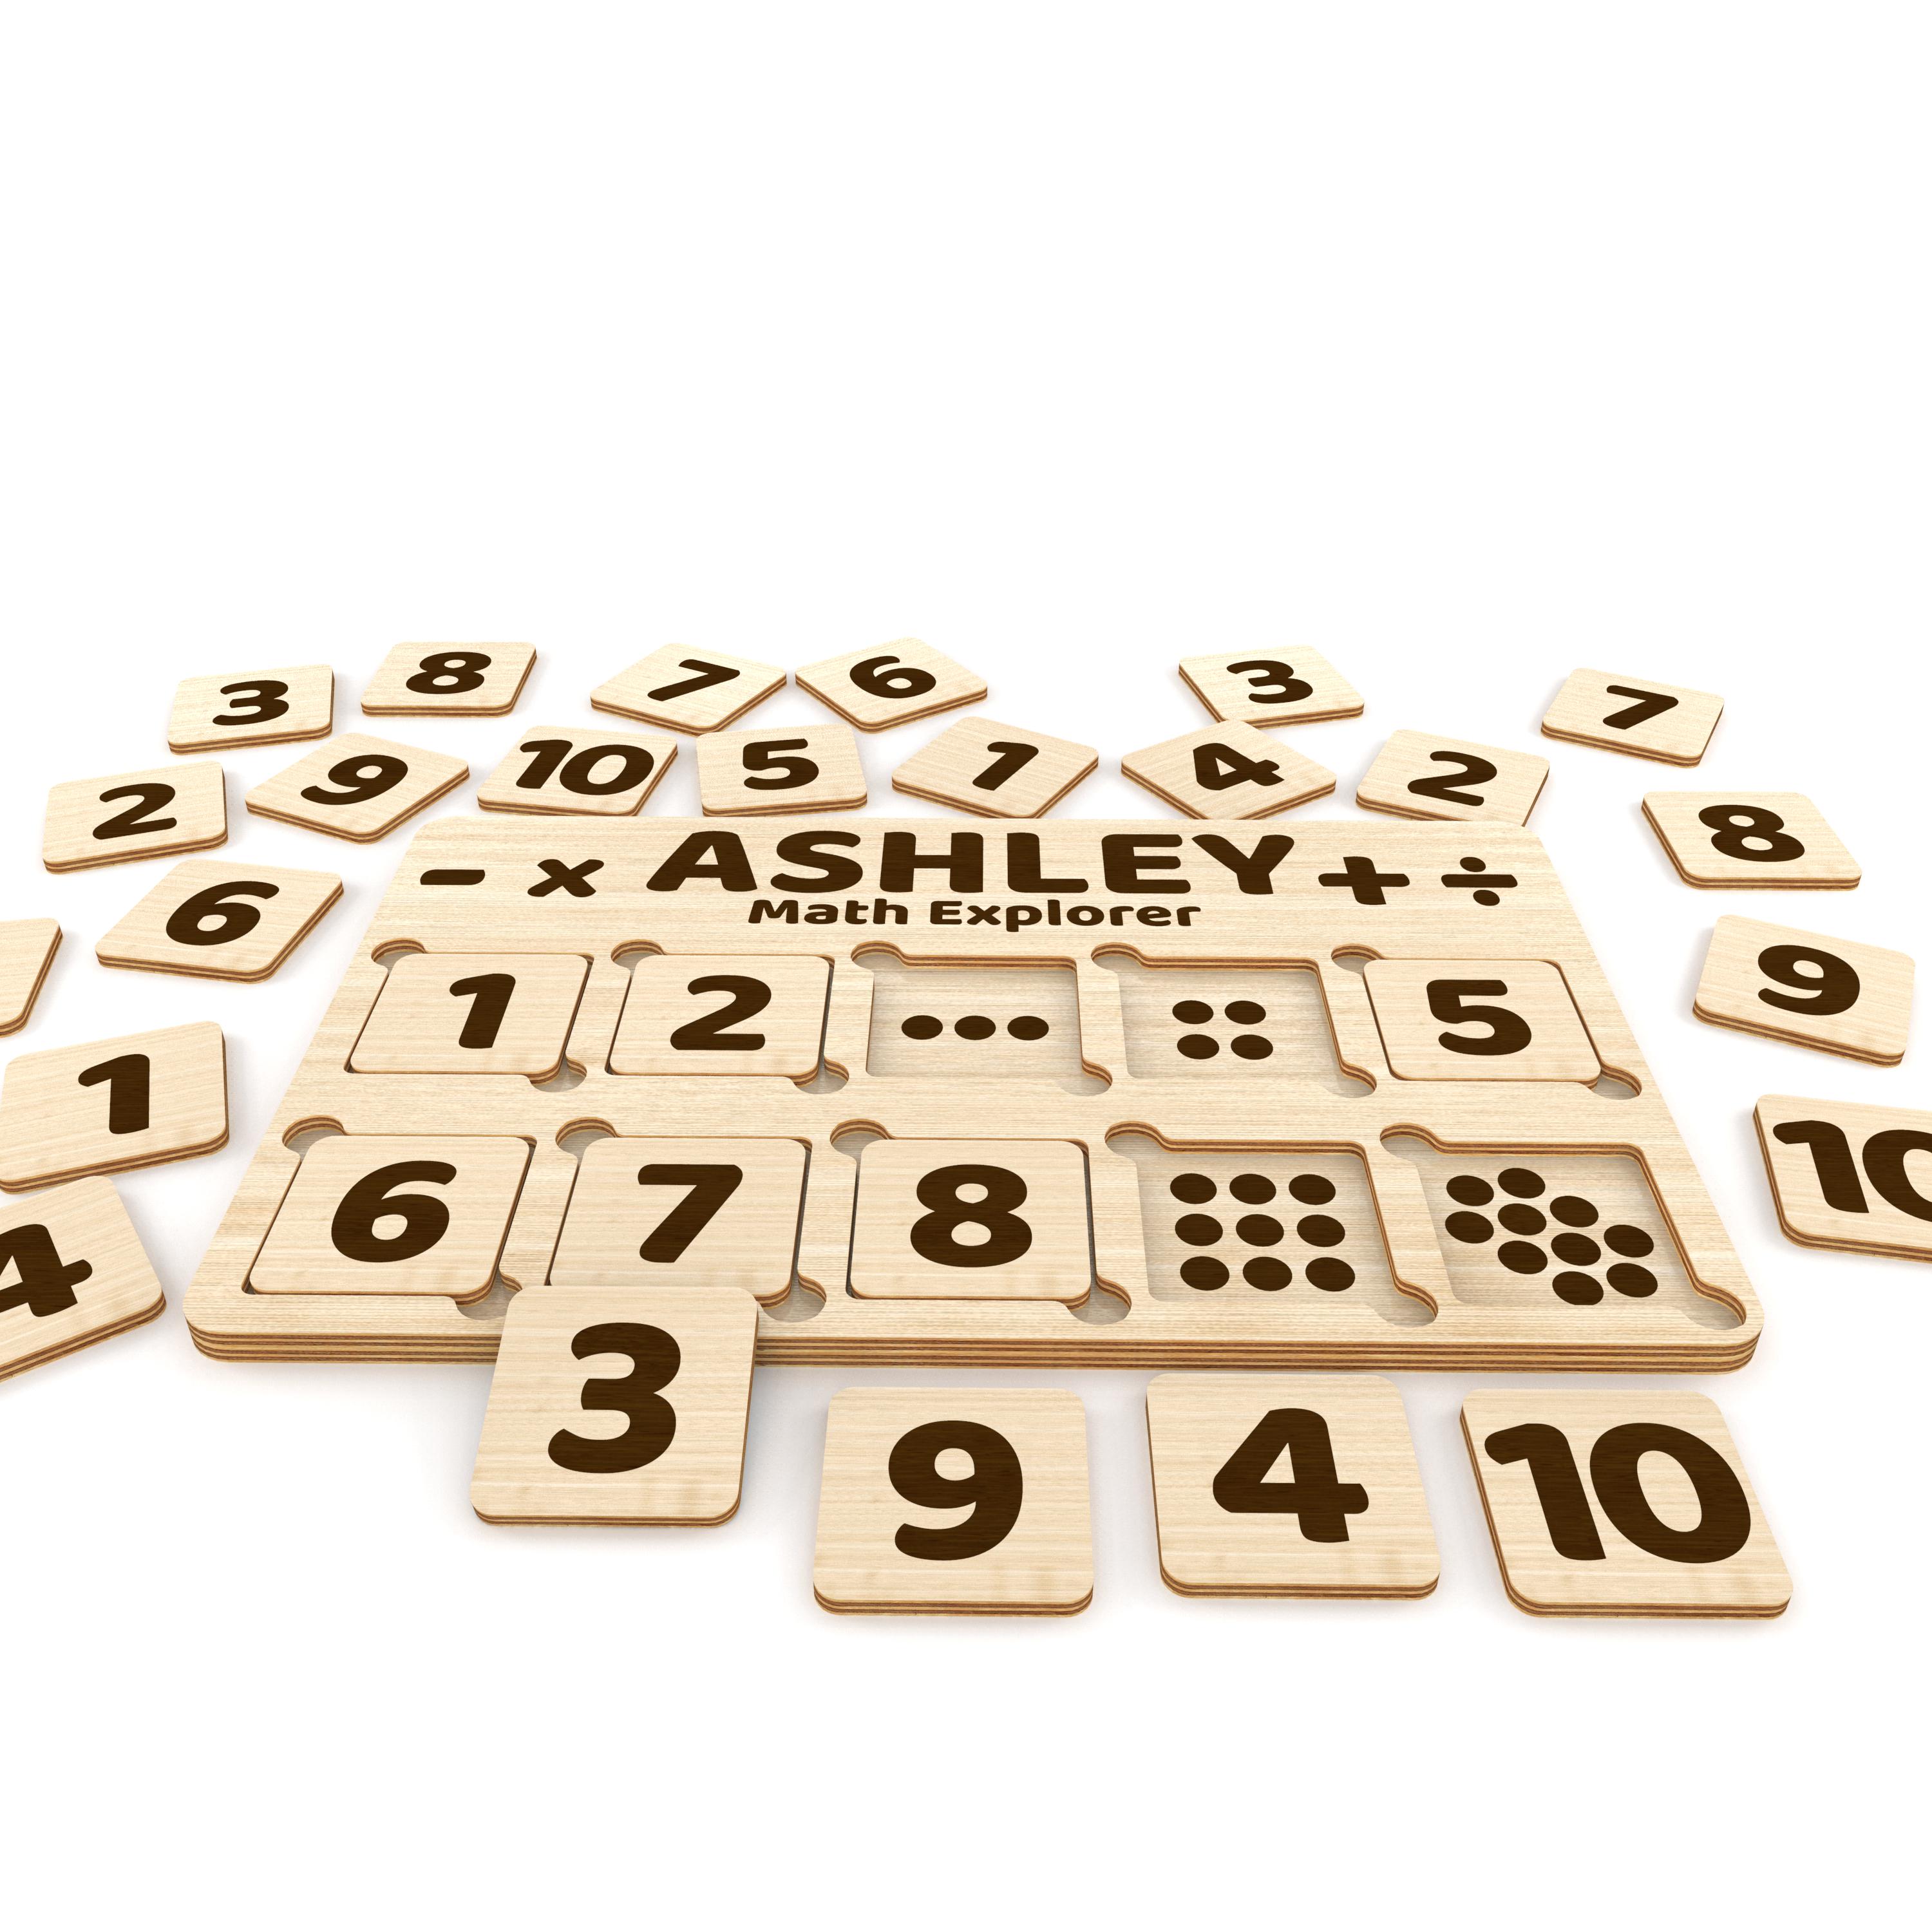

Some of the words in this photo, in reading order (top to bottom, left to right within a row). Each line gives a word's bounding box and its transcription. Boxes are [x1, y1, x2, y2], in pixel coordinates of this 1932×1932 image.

[213, 681, 289, 725] 3
[406, 652, 491, 694] 8
[648, 659, 740, 701] 7
[850, 656, 936, 698] 6
[1227, 661, 1312, 703] 3
[1603, 685, 1678, 730] 7
[301, 755, 408, 805] 9
[516, 740, 654, 795] 10
[743, 739, 819, 790] 5
[972, 742, 1038, 790] 1
[1193, 743, 1283, 790] 4
[1408, 752, 1497, 806] 2
[93, 784, 176, 839] 2
[1699, 805, 1804, 862] 8
[647, 831, 1294, 895] ASHLEY
[166, 882, 279, 945] 6
[748, 899, 907, 925] Math
[931, 900, 1200, 932] Explorer
[1758, 945, 1860, 1015] 9
[450, 974, 515, 1048] 1
[670, 975, 771, 1050] 2
[1426, 980, 1531, 1056] 5
[79, 1054, 149, 1134] 1
[332, 1161, 456, 1262] 6
[638, 1164, 743, 1262] 7
[911, 1165, 1032, 1267] 8
[0, 1224, 92, 1317] 4
[548, 1323, 680, 1473] 3
[889, 1421, 1023, 1560] 9
[1213, 1408, 1368, 1542] 4
[1485, 1424, 1750, 1563] 10
